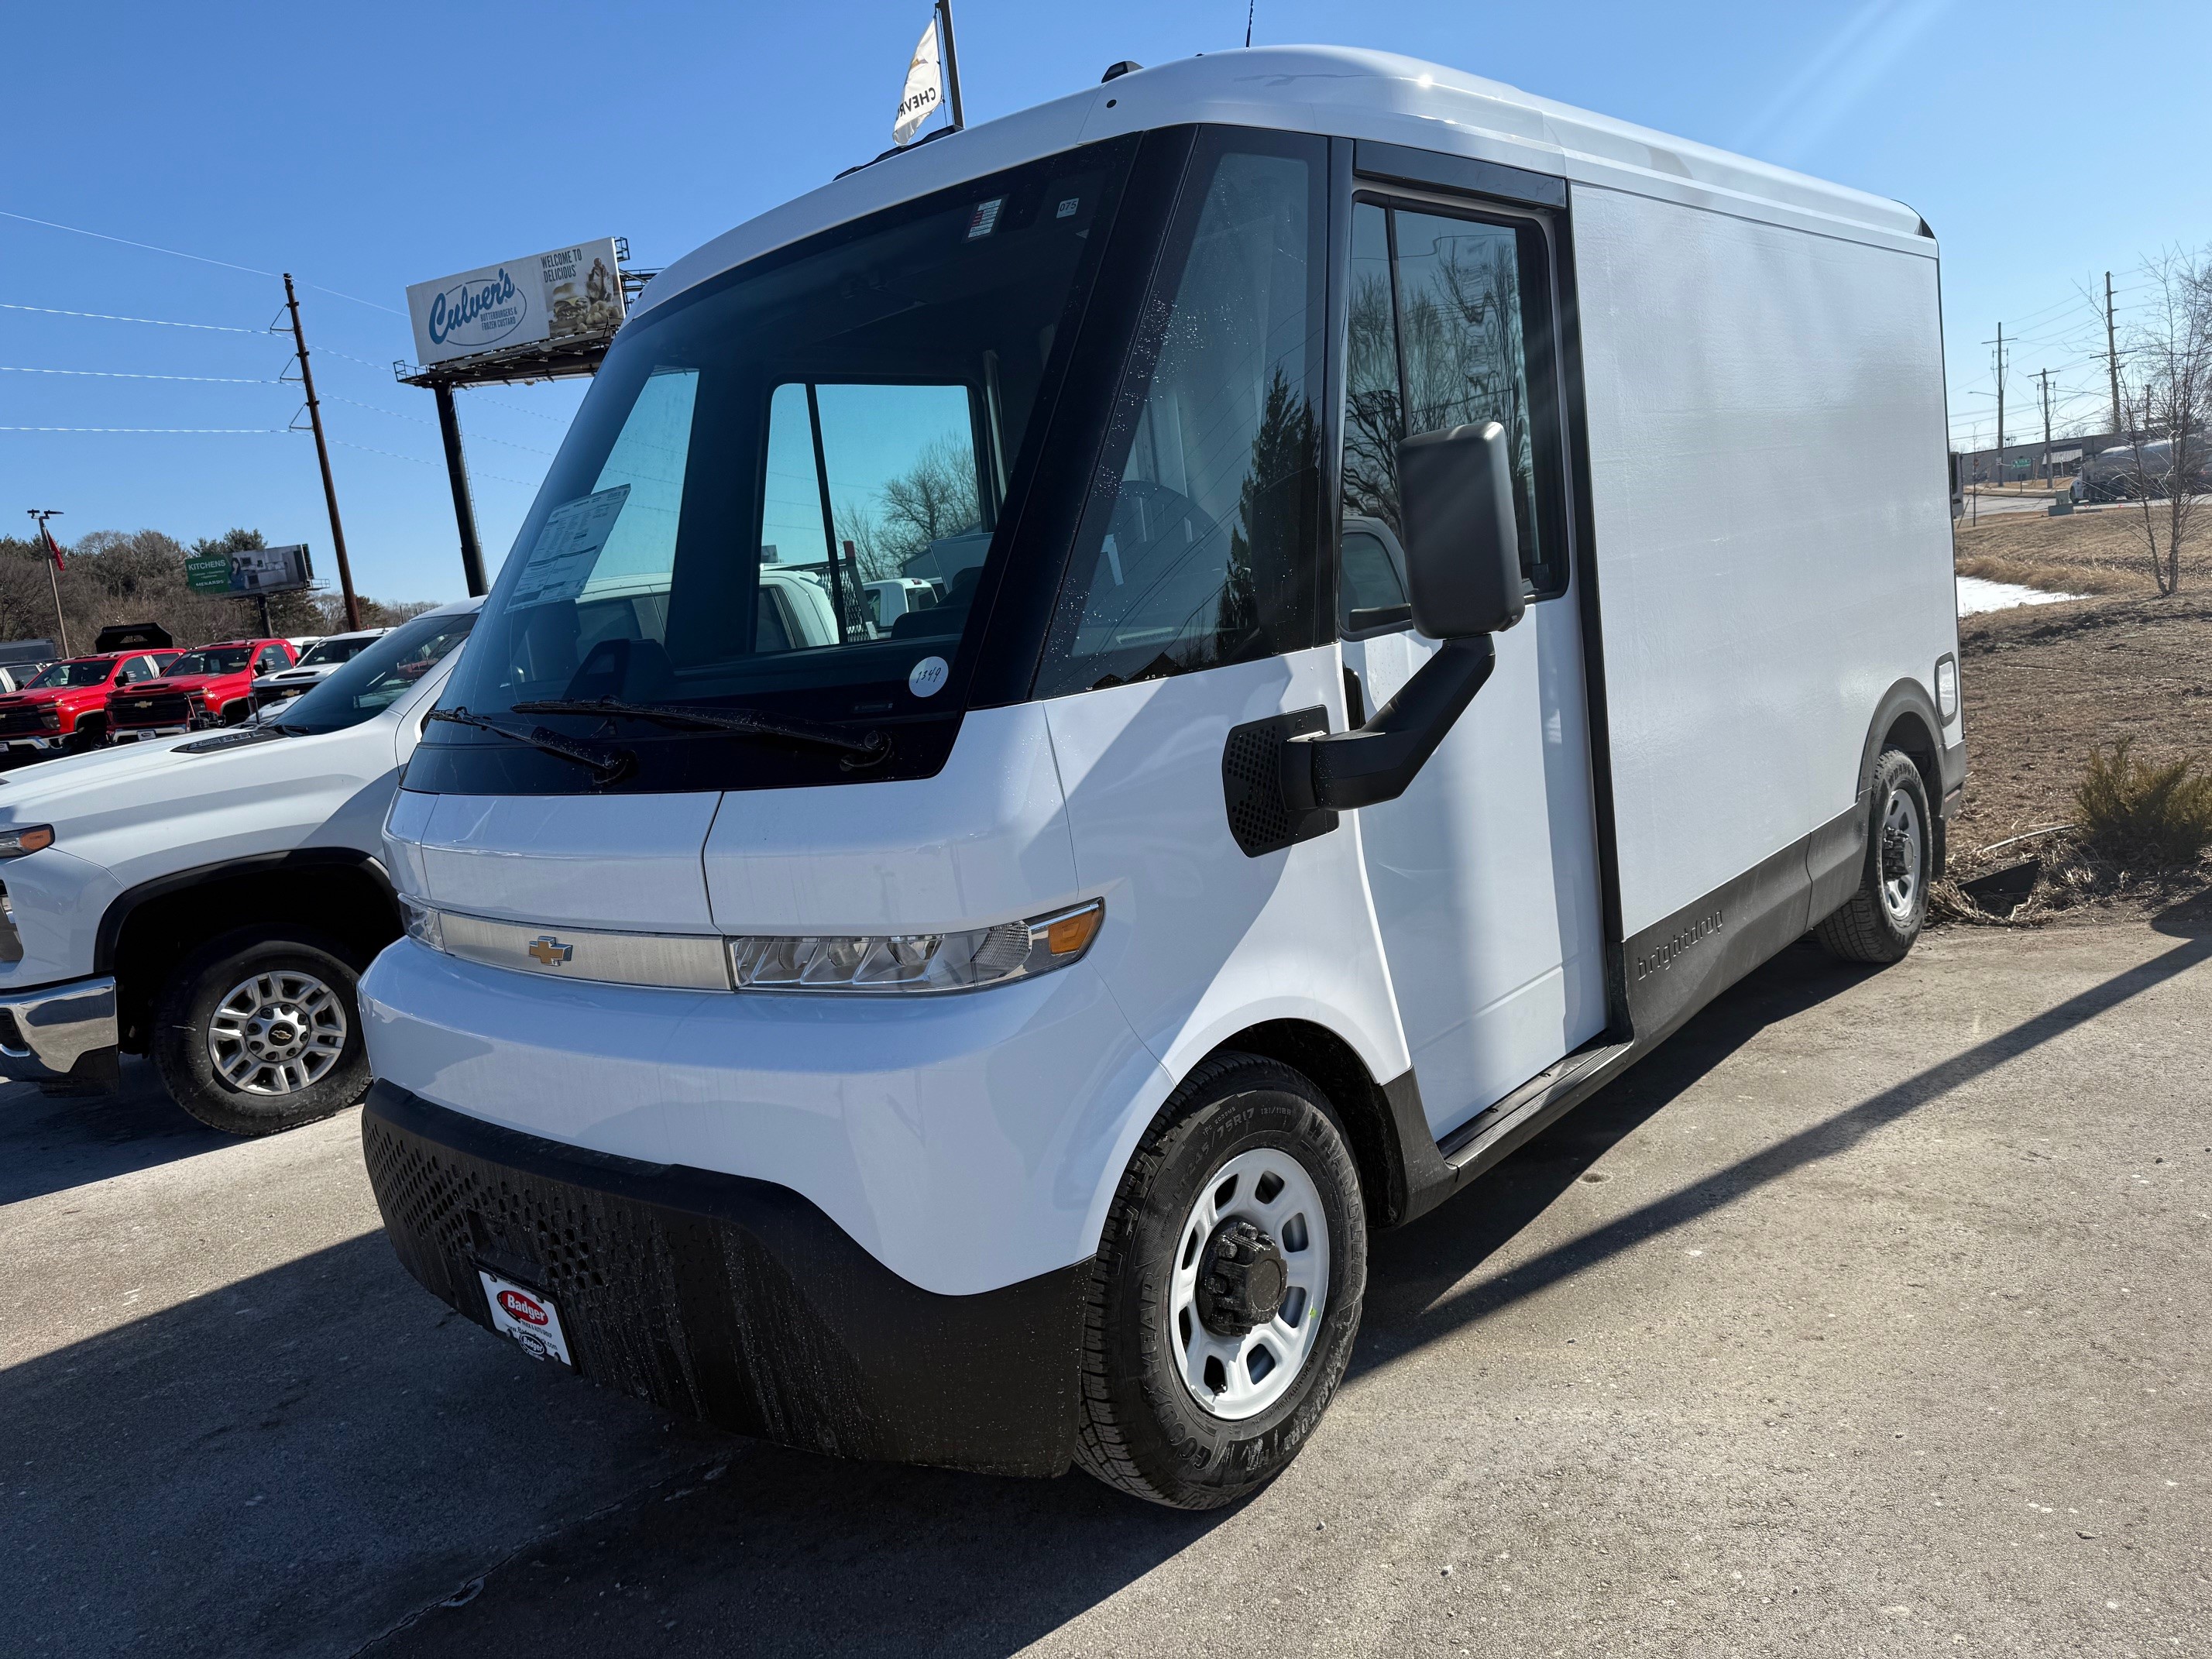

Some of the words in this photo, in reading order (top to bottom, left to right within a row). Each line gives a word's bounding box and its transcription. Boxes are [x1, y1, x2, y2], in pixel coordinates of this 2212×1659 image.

[1060, 201, 1077, 211] 075
[541, 251, 572, 269] WELCOME
[572, 248, 582, 262] TO
[543, 264, 576, 283] DELICIOUS
[429, 268, 515, 345] Culver's
[480, 307, 514, 322] BUTTERBURGERS
[482, 320, 497, 331] FROZEN
[497, 316, 517, 328] CUSTARD
[188, 559, 226, 571] KITCHENS
[916, 667, 942, 683] 1349
[1637, 910, 1723, 981] brightdrop
[507, 1294, 545, 1321] Badger
[523, 1336, 543, 1352] Badger
[1139, 1271, 1211, 1471] GOODYEAR
